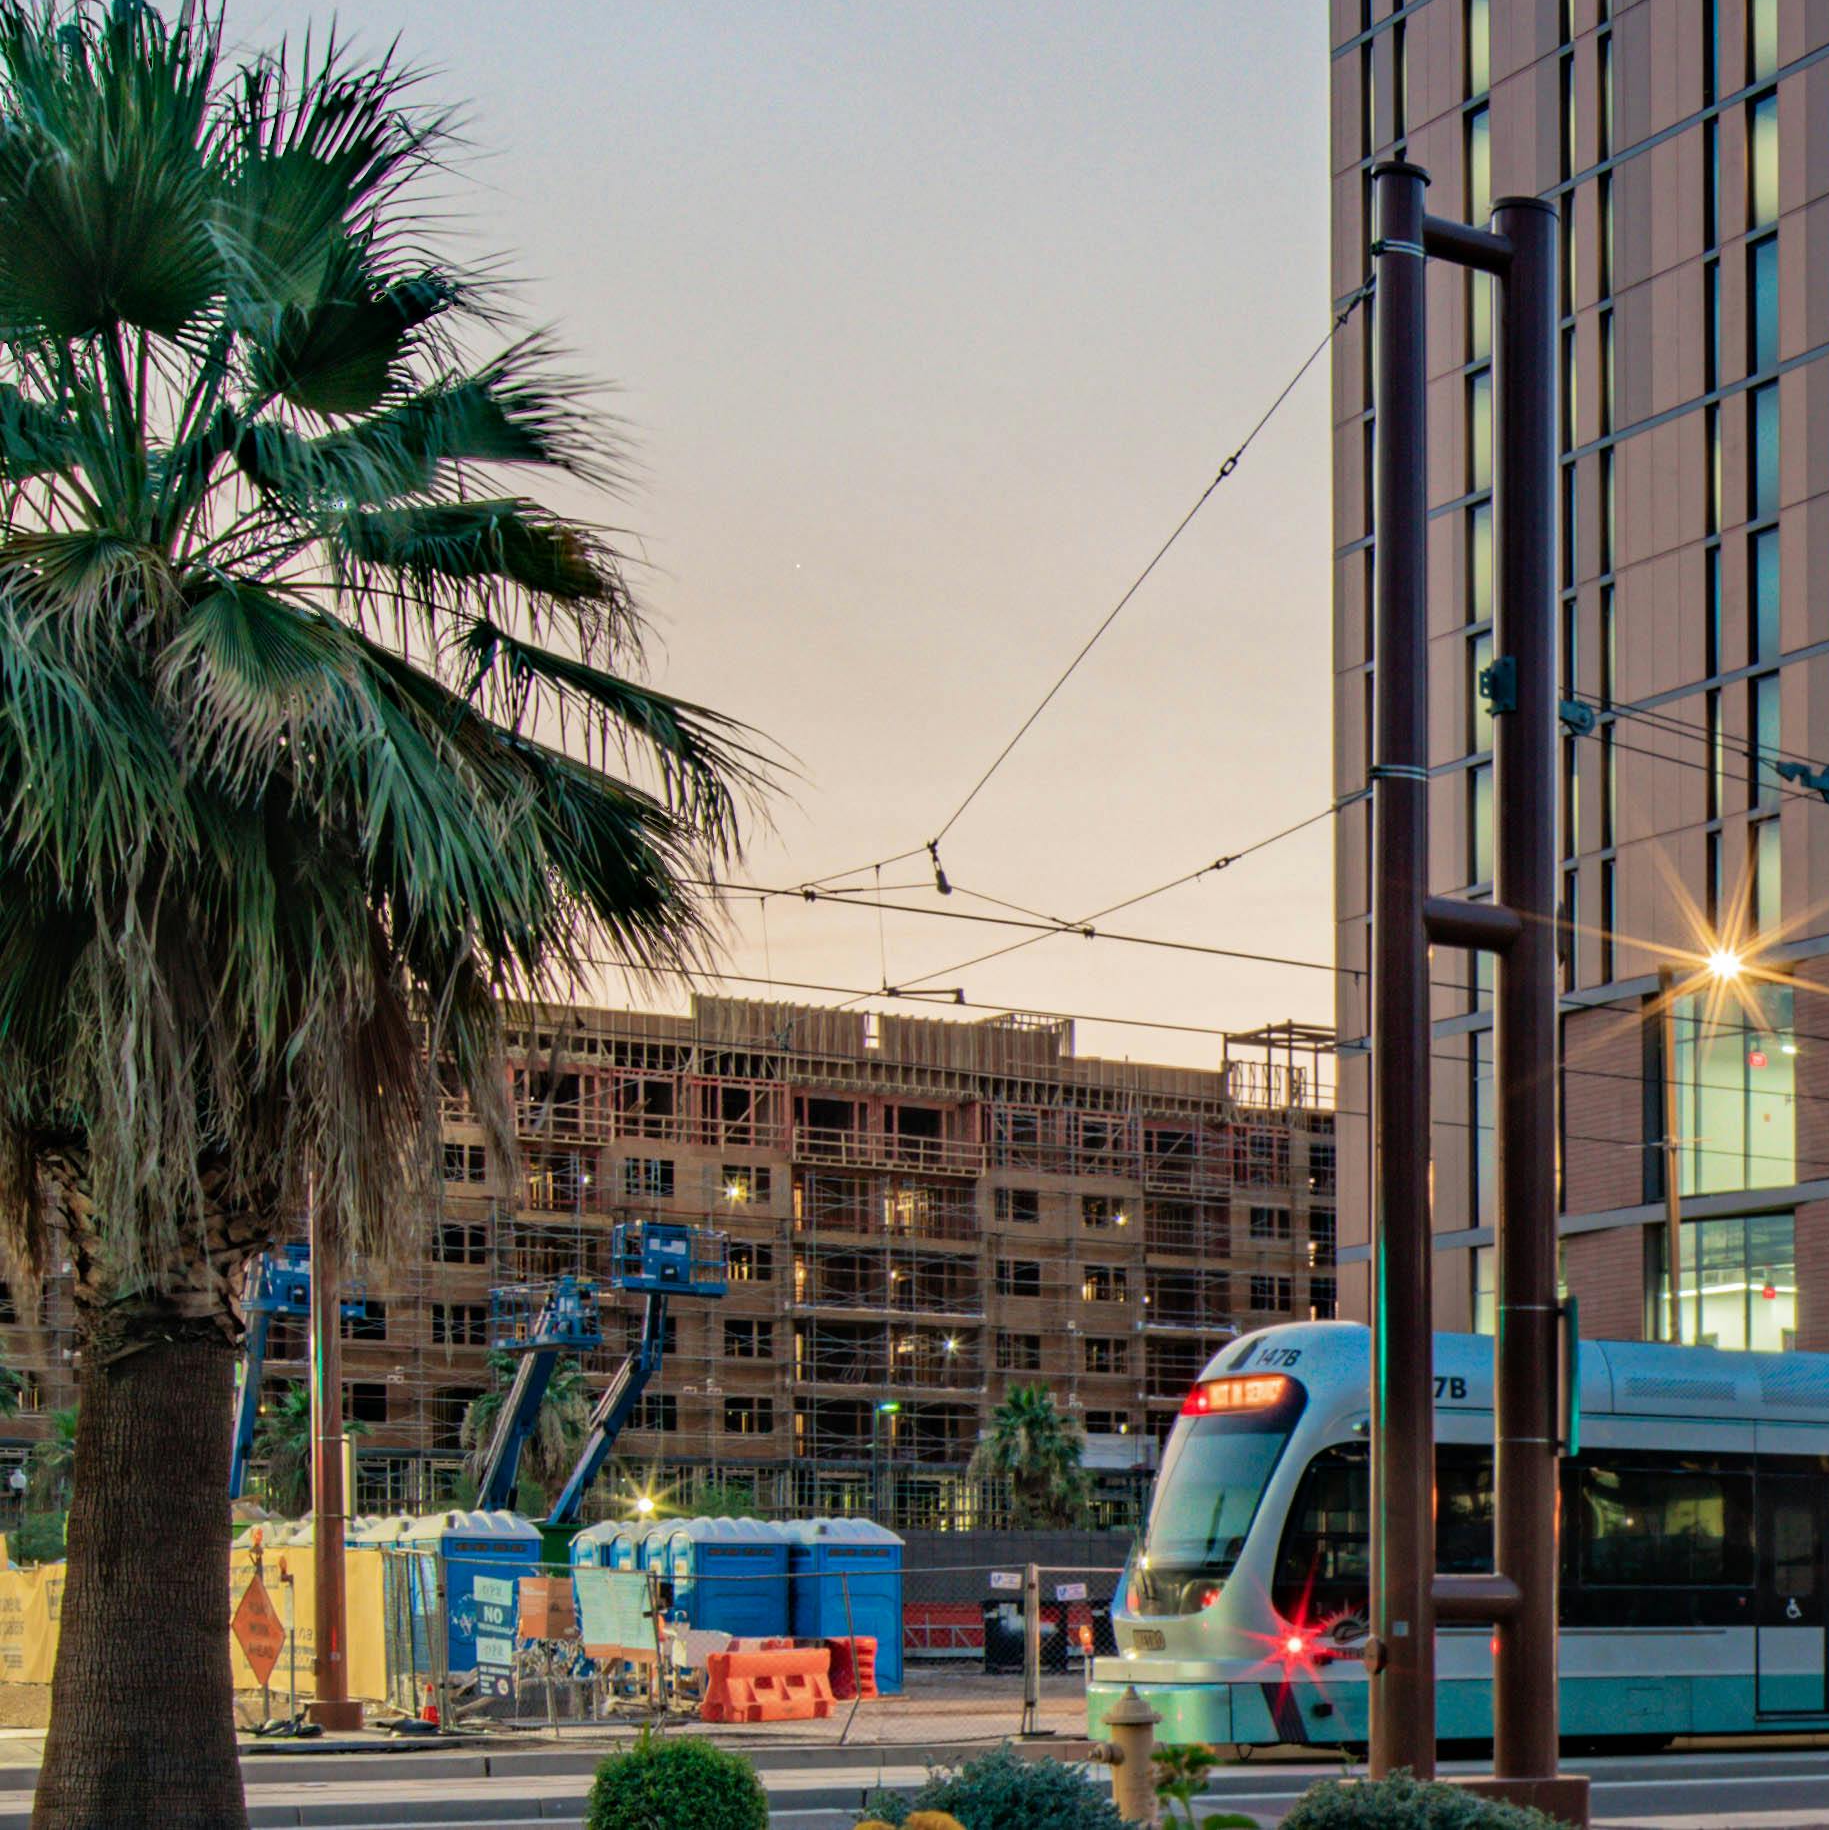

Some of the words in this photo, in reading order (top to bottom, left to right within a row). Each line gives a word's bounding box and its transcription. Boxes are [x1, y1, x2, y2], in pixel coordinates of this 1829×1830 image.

[1256, 1349, 1302, 1367] 147B
[1434, 1376, 1467, 1399] 7B
[483, 1605, 503, 1624] NO
